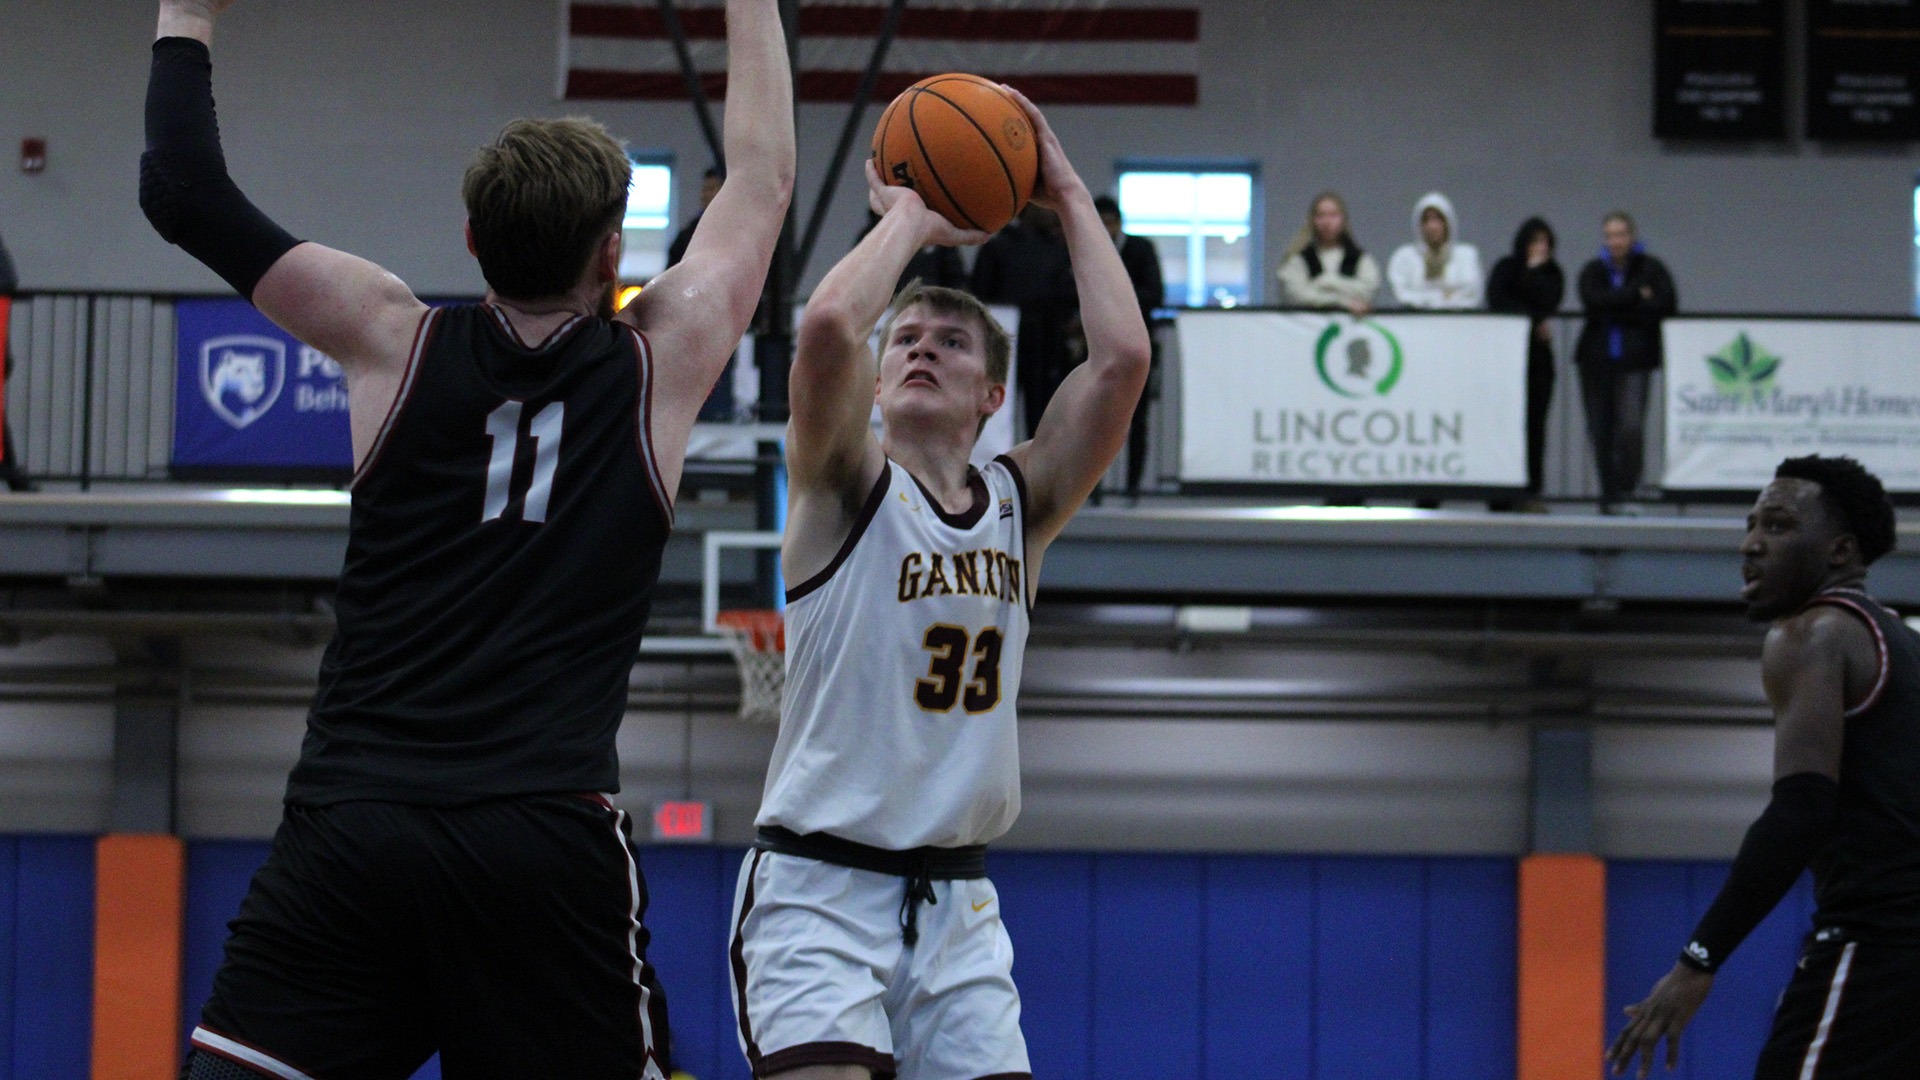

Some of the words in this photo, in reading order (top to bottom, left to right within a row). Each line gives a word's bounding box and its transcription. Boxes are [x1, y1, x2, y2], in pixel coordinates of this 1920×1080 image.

[1253, 409, 1463, 445] LINCOLN
[481, 399, 565, 523] 11
[1252, 450, 1466, 476] RECYCLING
[913, 621, 1002, 715] 33
[662, 802, 704, 837] EXIT
